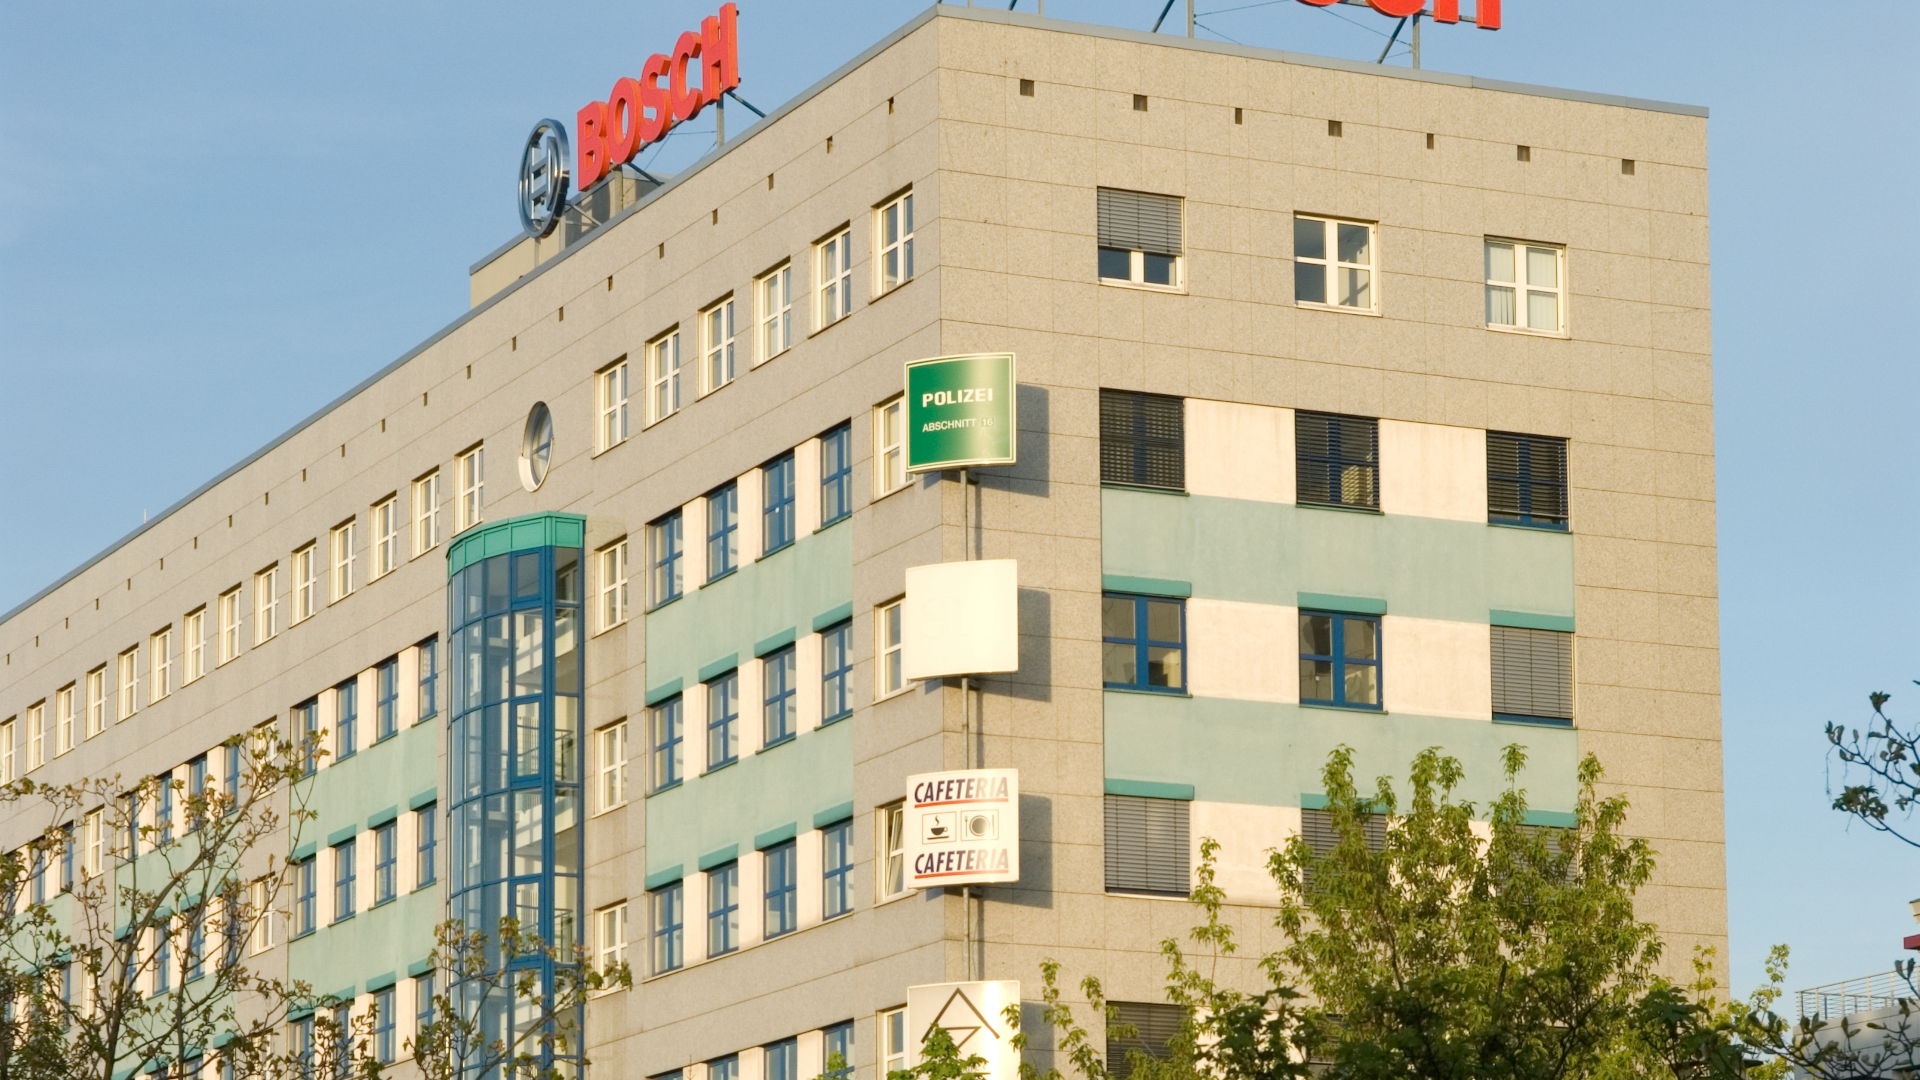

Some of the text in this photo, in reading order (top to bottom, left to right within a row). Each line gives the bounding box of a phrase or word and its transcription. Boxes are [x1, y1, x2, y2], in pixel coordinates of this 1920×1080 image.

[577, 2, 739, 192] BOSCH
[922, 388, 993, 408] POLIZEI
[922, 418, 977, 433] ABSCHNITT
[914, 777, 1008, 803] CAFETERIA
[914, 848, 1008, 874] CAFETERIA
